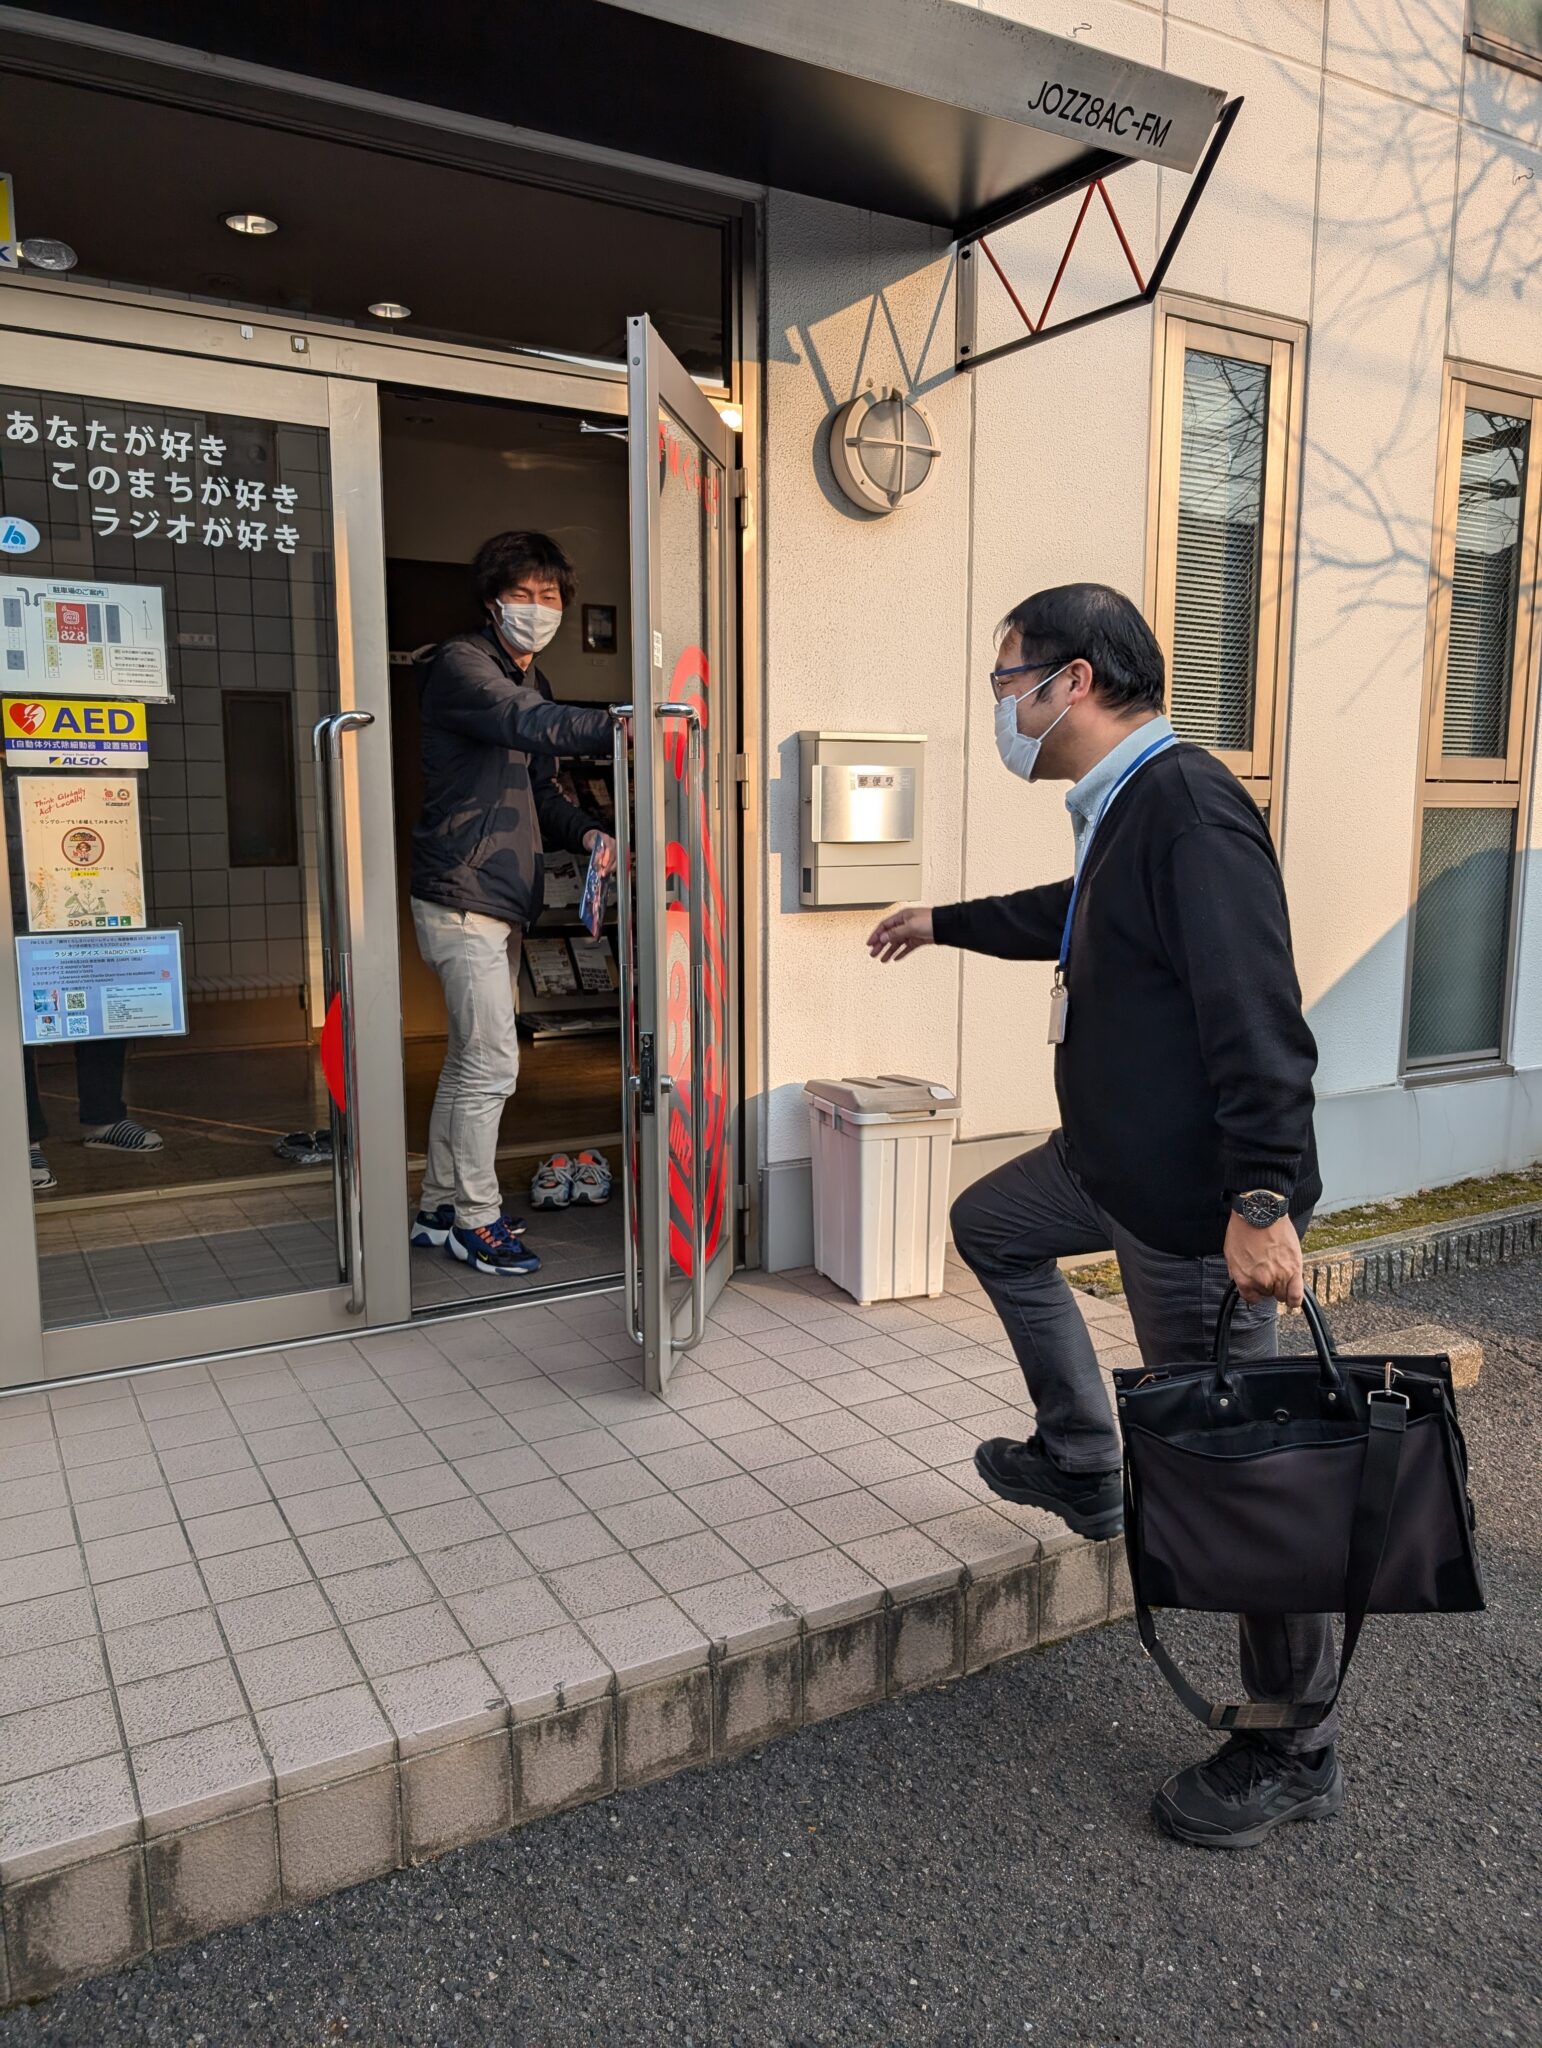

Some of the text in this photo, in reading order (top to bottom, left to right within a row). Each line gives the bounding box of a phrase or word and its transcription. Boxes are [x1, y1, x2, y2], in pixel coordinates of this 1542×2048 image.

[1028, 81, 1172, 147] JOZZ8AC-FM
[6, 411, 227, 466] あなたが好き
[52, 461, 298, 514] このまちが好き
[92, 507, 299, 554] ラジオが好き
[52, 586, 105, 597] 駐車場のご案内
[52, 708, 135, 734] AED
[62, 757, 108, 766] ALSOK
[34, 798, 54, 808] Think
[40, 805, 52, 816] Act
